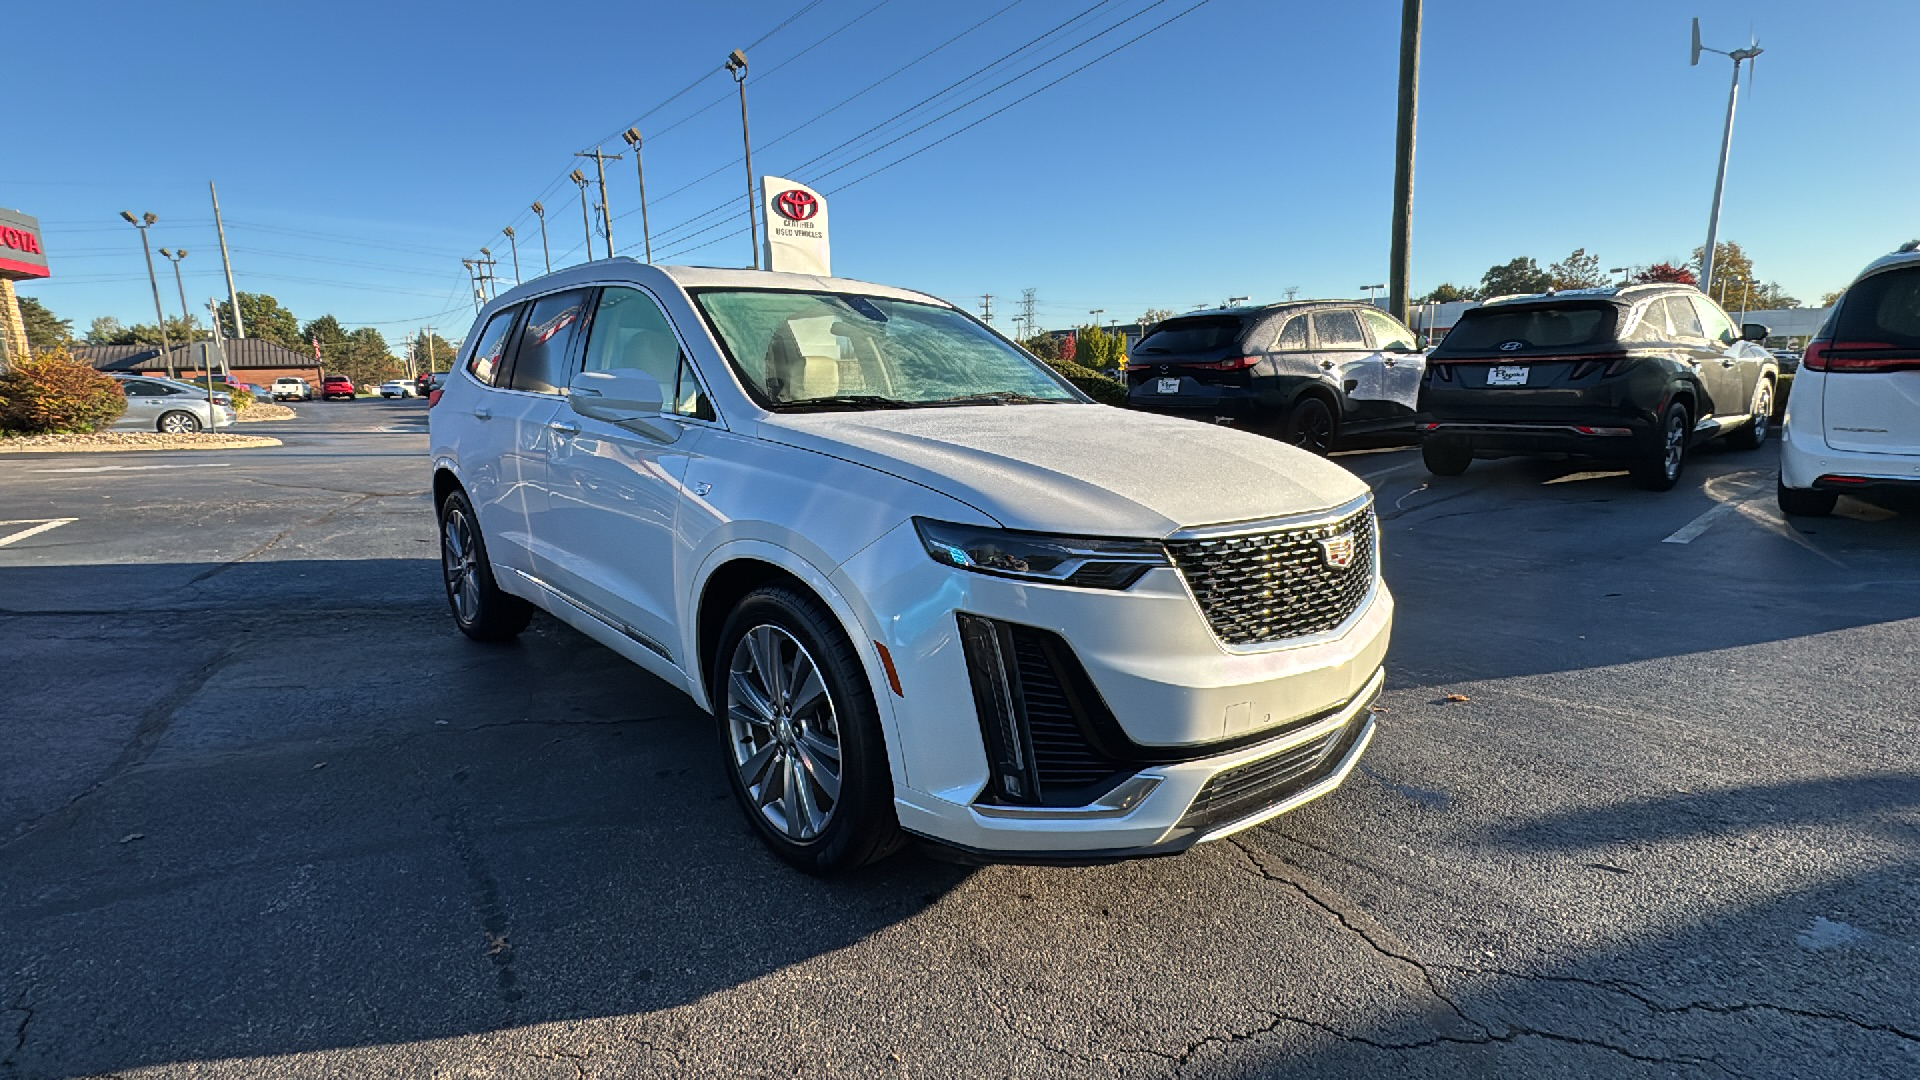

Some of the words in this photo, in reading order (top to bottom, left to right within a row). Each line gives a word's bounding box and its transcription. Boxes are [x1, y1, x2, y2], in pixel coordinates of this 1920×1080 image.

[783, 220, 814, 228] CERTIFIED
[776, 228, 792, 236] USED
[794, 230, 822, 238] VEHICLES
